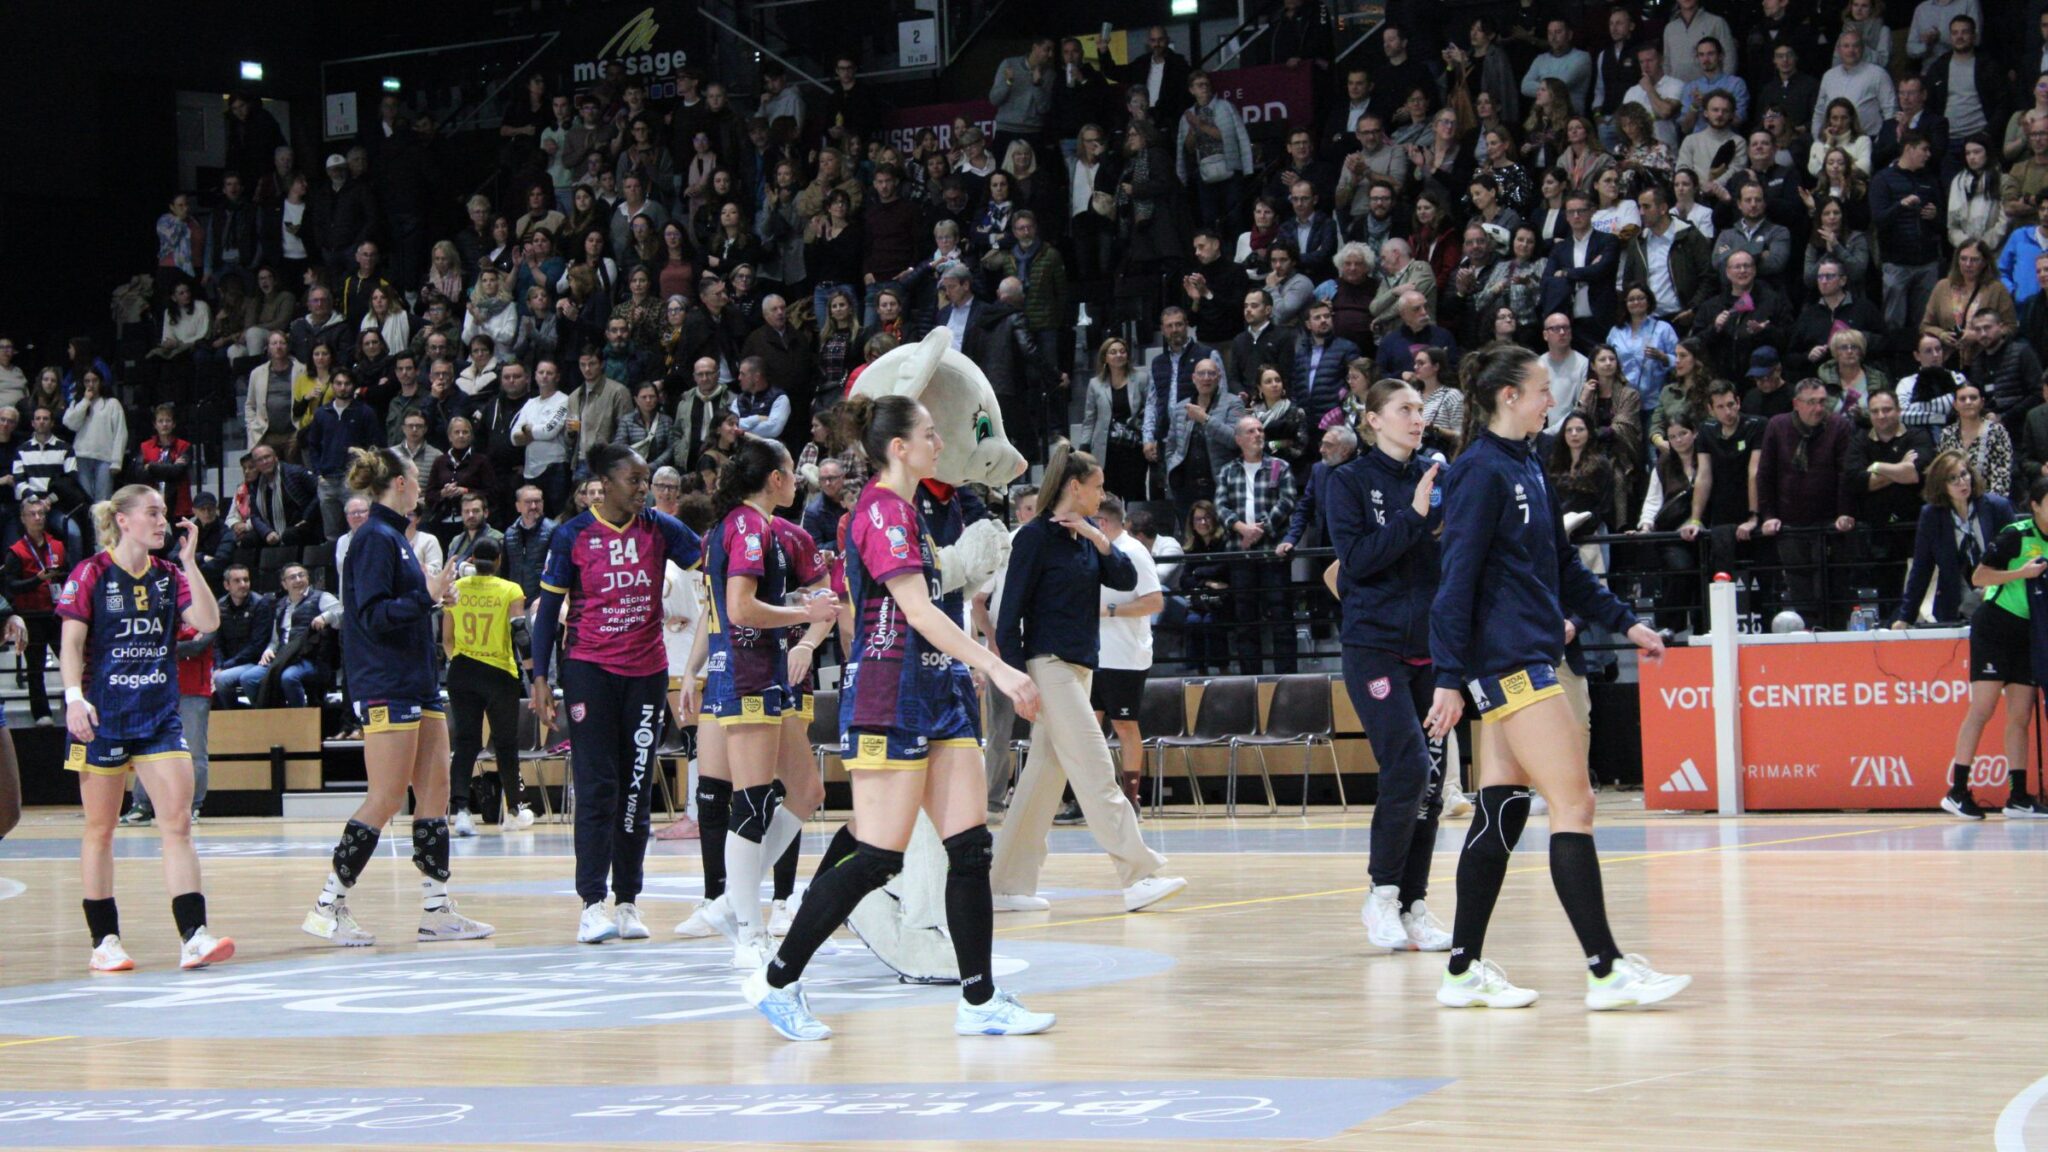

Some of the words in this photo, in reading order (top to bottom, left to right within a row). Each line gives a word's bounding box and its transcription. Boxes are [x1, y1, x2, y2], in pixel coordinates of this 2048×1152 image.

[912, 29, 921, 44] 2
[573, 49, 687, 82] mesage
[1373, 507, 1386, 526] 16
[1518, 503, 1530, 524] 7
[608, 537, 639, 566] 24
[600, 569, 652, 593] JDA
[132, 585, 149, 611] 2
[114, 617, 164, 638] JDA
[461, 611, 495, 646] 97
[111, 645, 168, 658] CHOPARD
[108, 668, 168, 689] sogedo
[1748, 683, 1848, 708] CENTRE
[1854, 681, 1889, 705] DE
[634, 704, 654, 791] INORIX
[1850, 755, 1914, 787] ZARA
